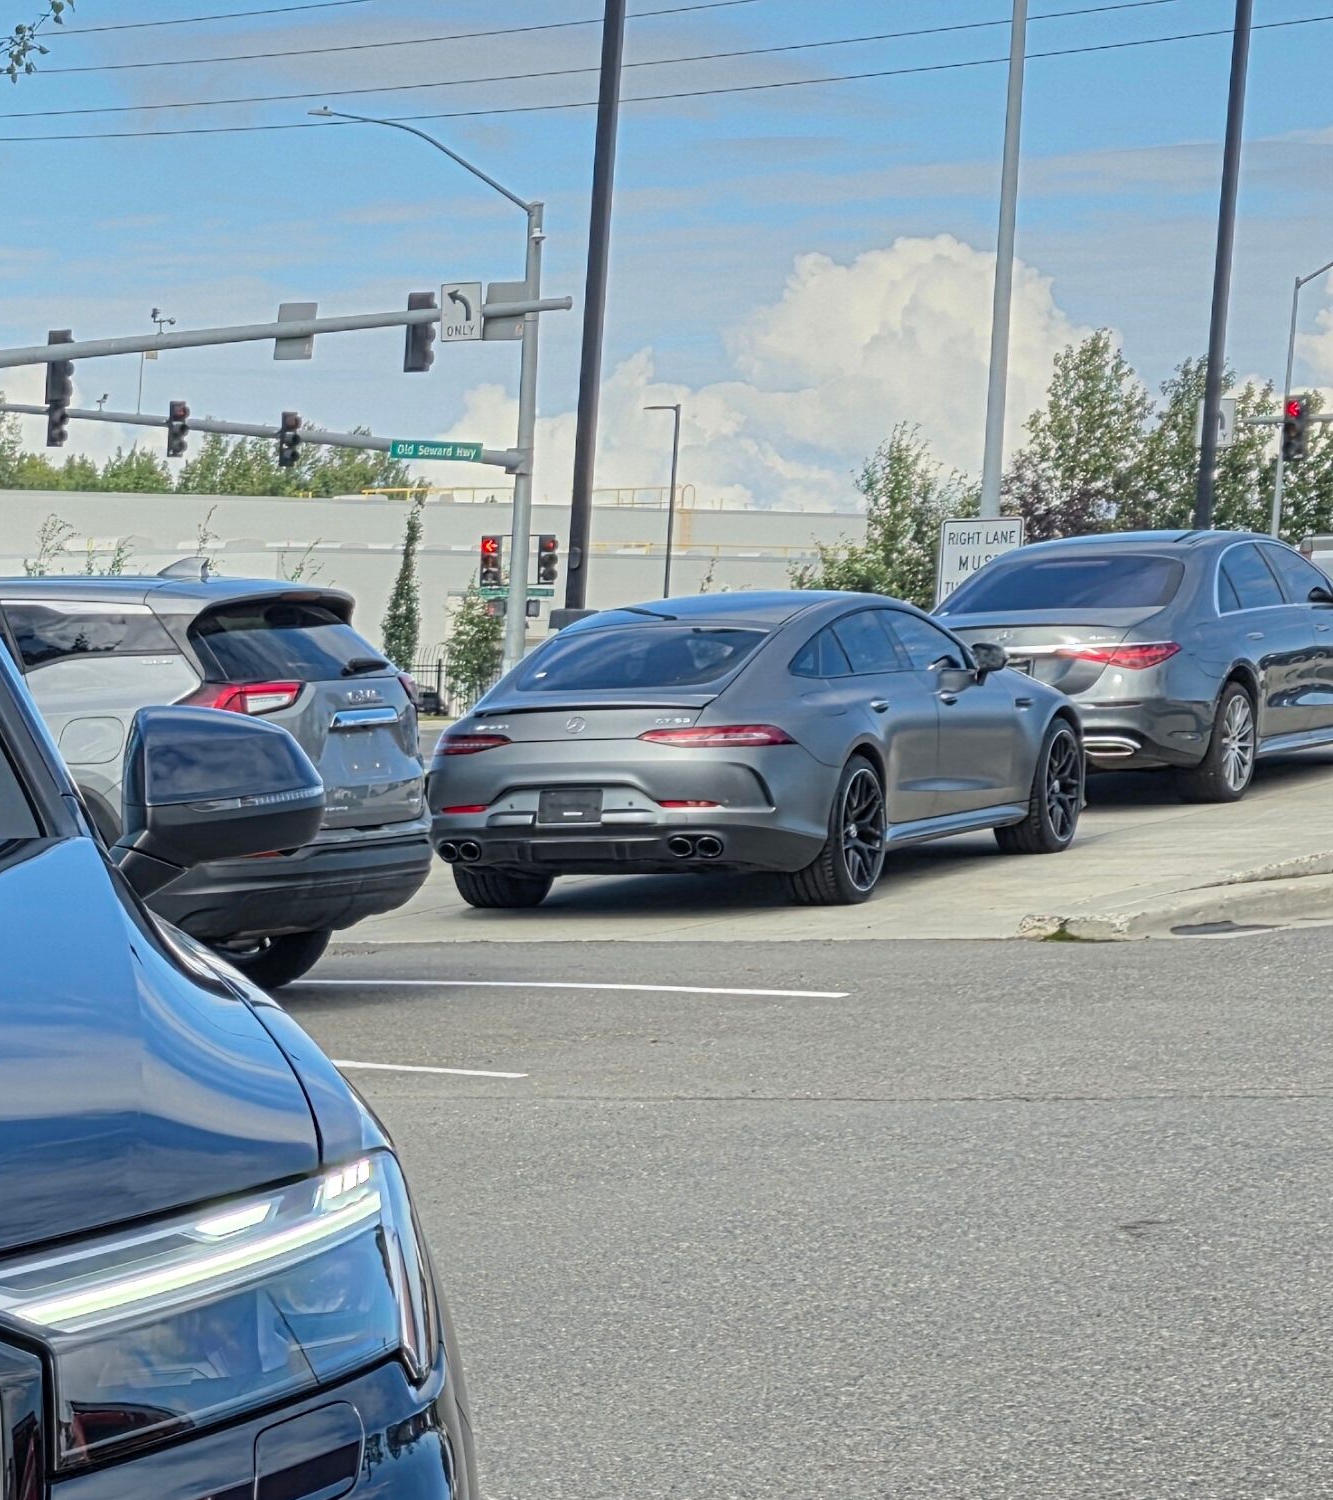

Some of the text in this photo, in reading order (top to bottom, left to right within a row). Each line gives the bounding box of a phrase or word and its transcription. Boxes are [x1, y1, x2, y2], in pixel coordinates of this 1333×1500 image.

[446, 325, 475, 337] ONLY
[397, 444, 477, 459] Old Seward Hwy
[948, 530, 1016, 545] RIGHT LANE
